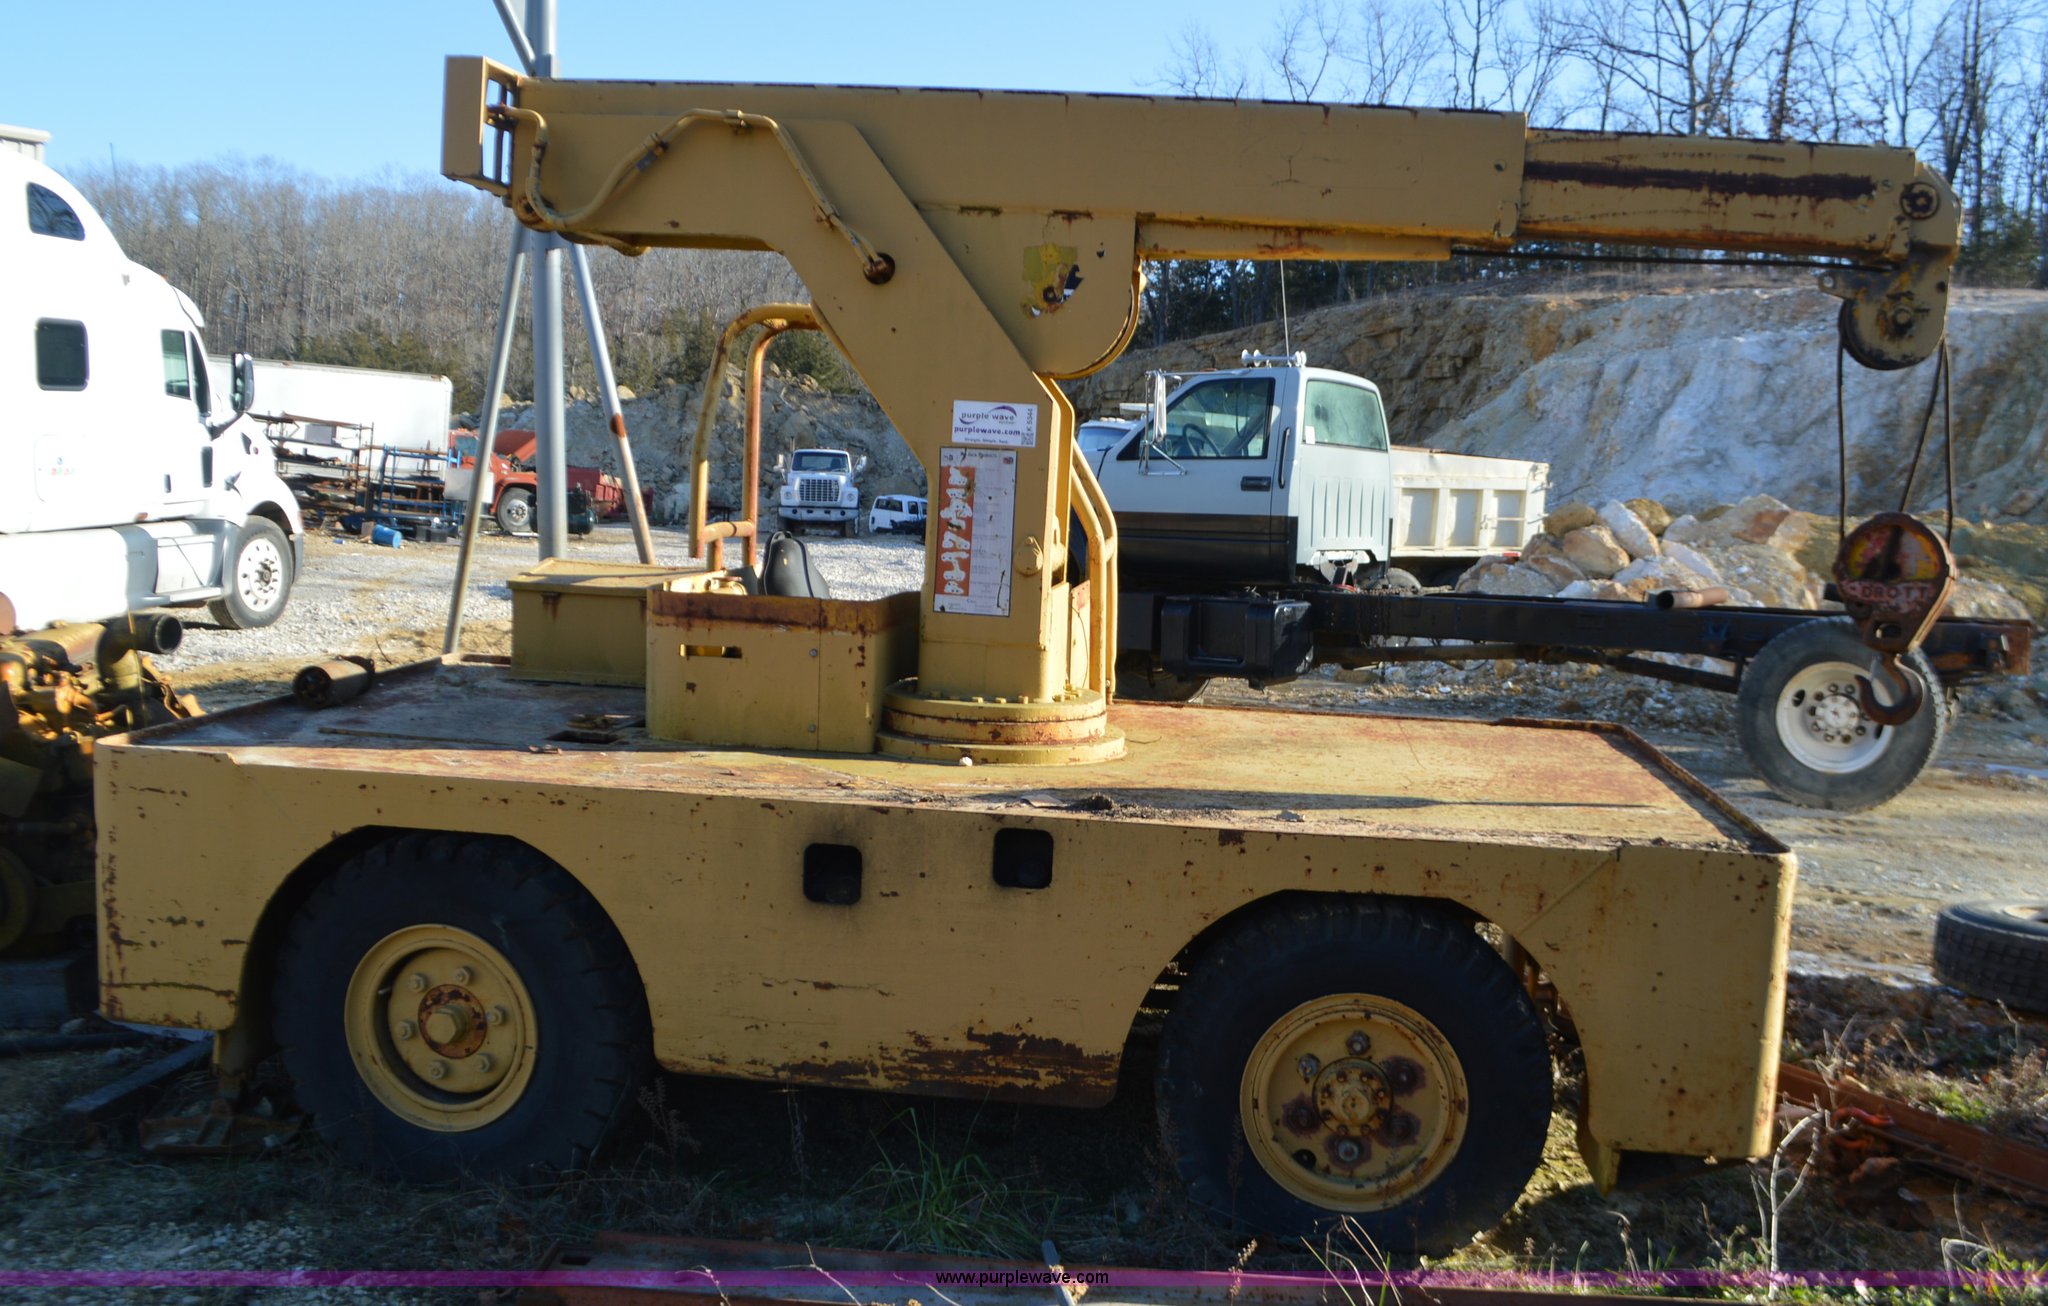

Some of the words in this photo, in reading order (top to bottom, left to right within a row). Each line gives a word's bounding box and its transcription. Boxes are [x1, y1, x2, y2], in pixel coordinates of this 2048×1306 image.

[961, 411, 989, 420] purple
[992, 413, 1015, 421] wave
[954, 426, 1020, 436] purplewave.com
